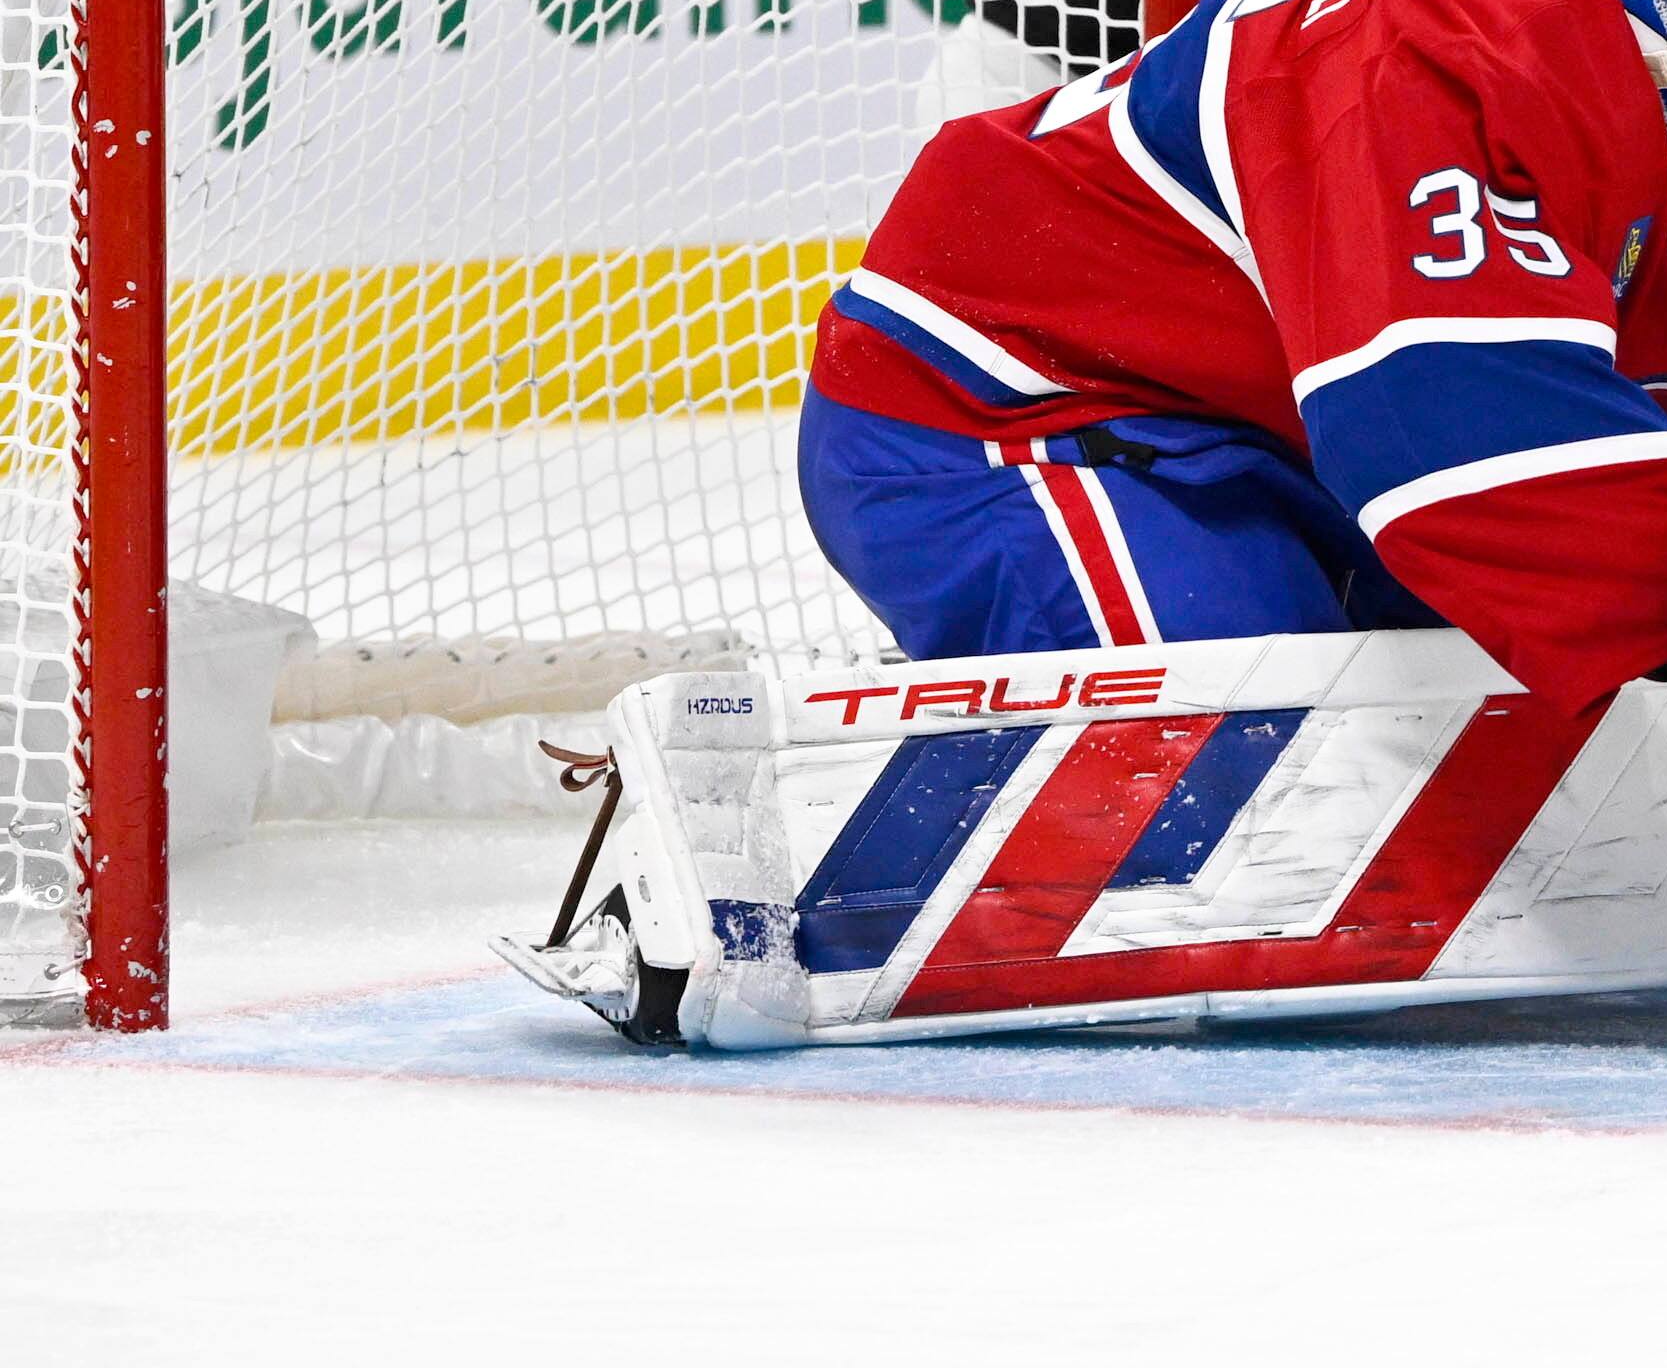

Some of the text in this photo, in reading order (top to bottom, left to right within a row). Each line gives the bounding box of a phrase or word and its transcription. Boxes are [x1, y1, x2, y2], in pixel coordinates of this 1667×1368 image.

[1407, 165, 1574, 282] 35
[686, 696, 754, 716] HZRDUS
[802, 667, 1168, 726] TRUE
